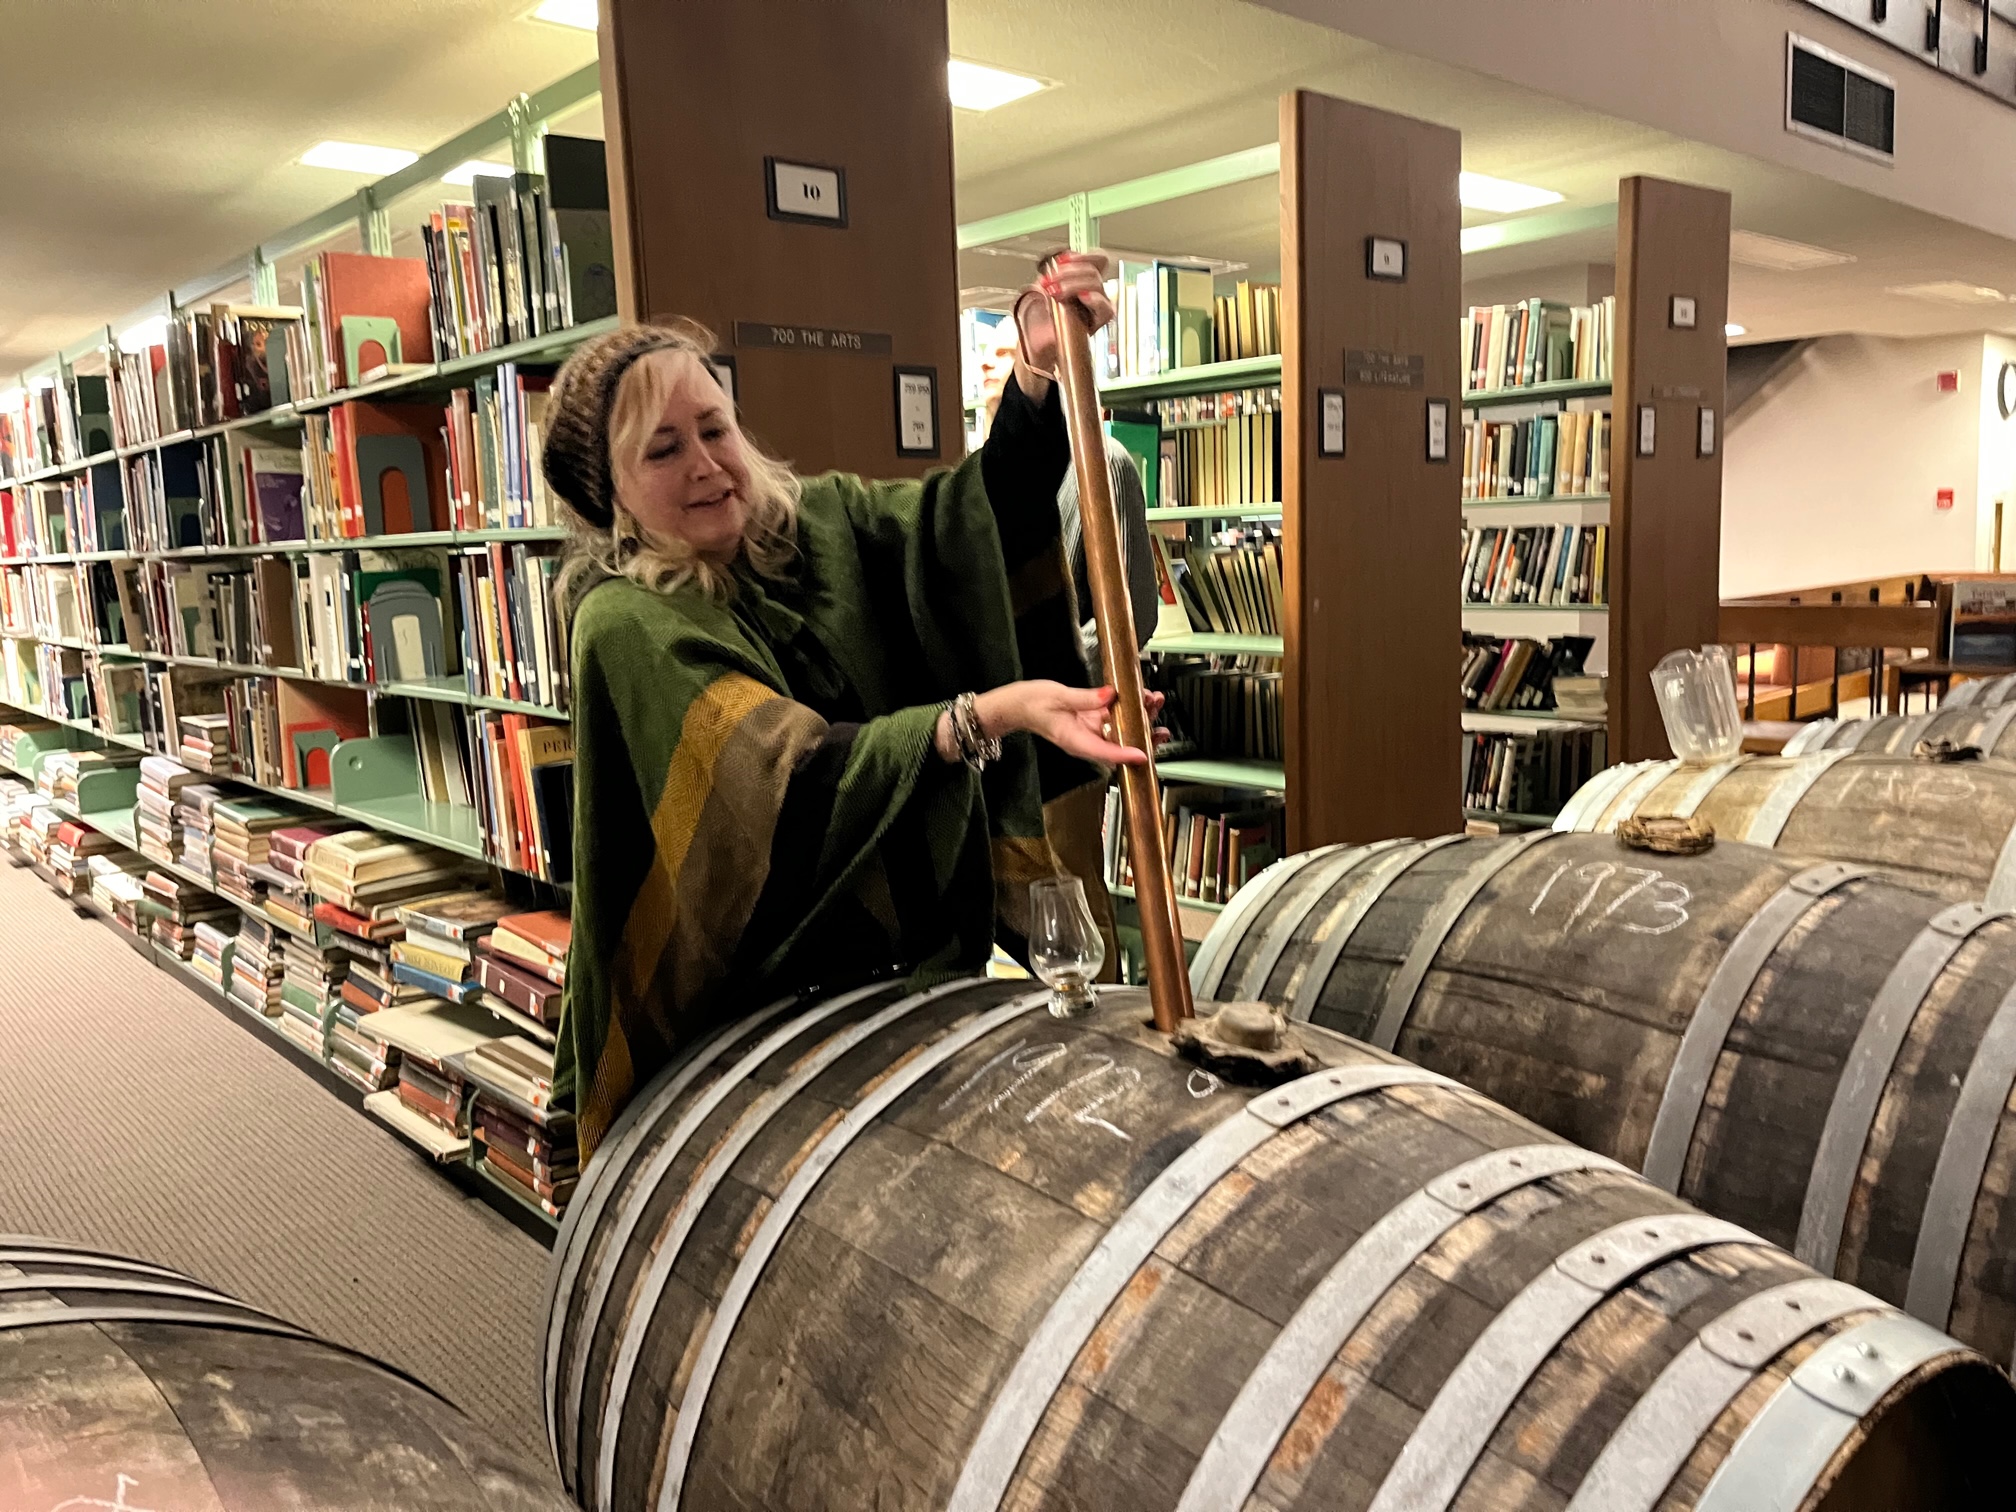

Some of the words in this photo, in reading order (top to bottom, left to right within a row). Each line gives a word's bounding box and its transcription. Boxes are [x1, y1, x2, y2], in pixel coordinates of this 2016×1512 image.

[802, 182, 821, 201] 10
[771, 327, 795, 344] 700
[800, 329, 825, 347] THE
[831, 332, 861, 350] ARTS
[1529, 859, 1693, 935] 1973
